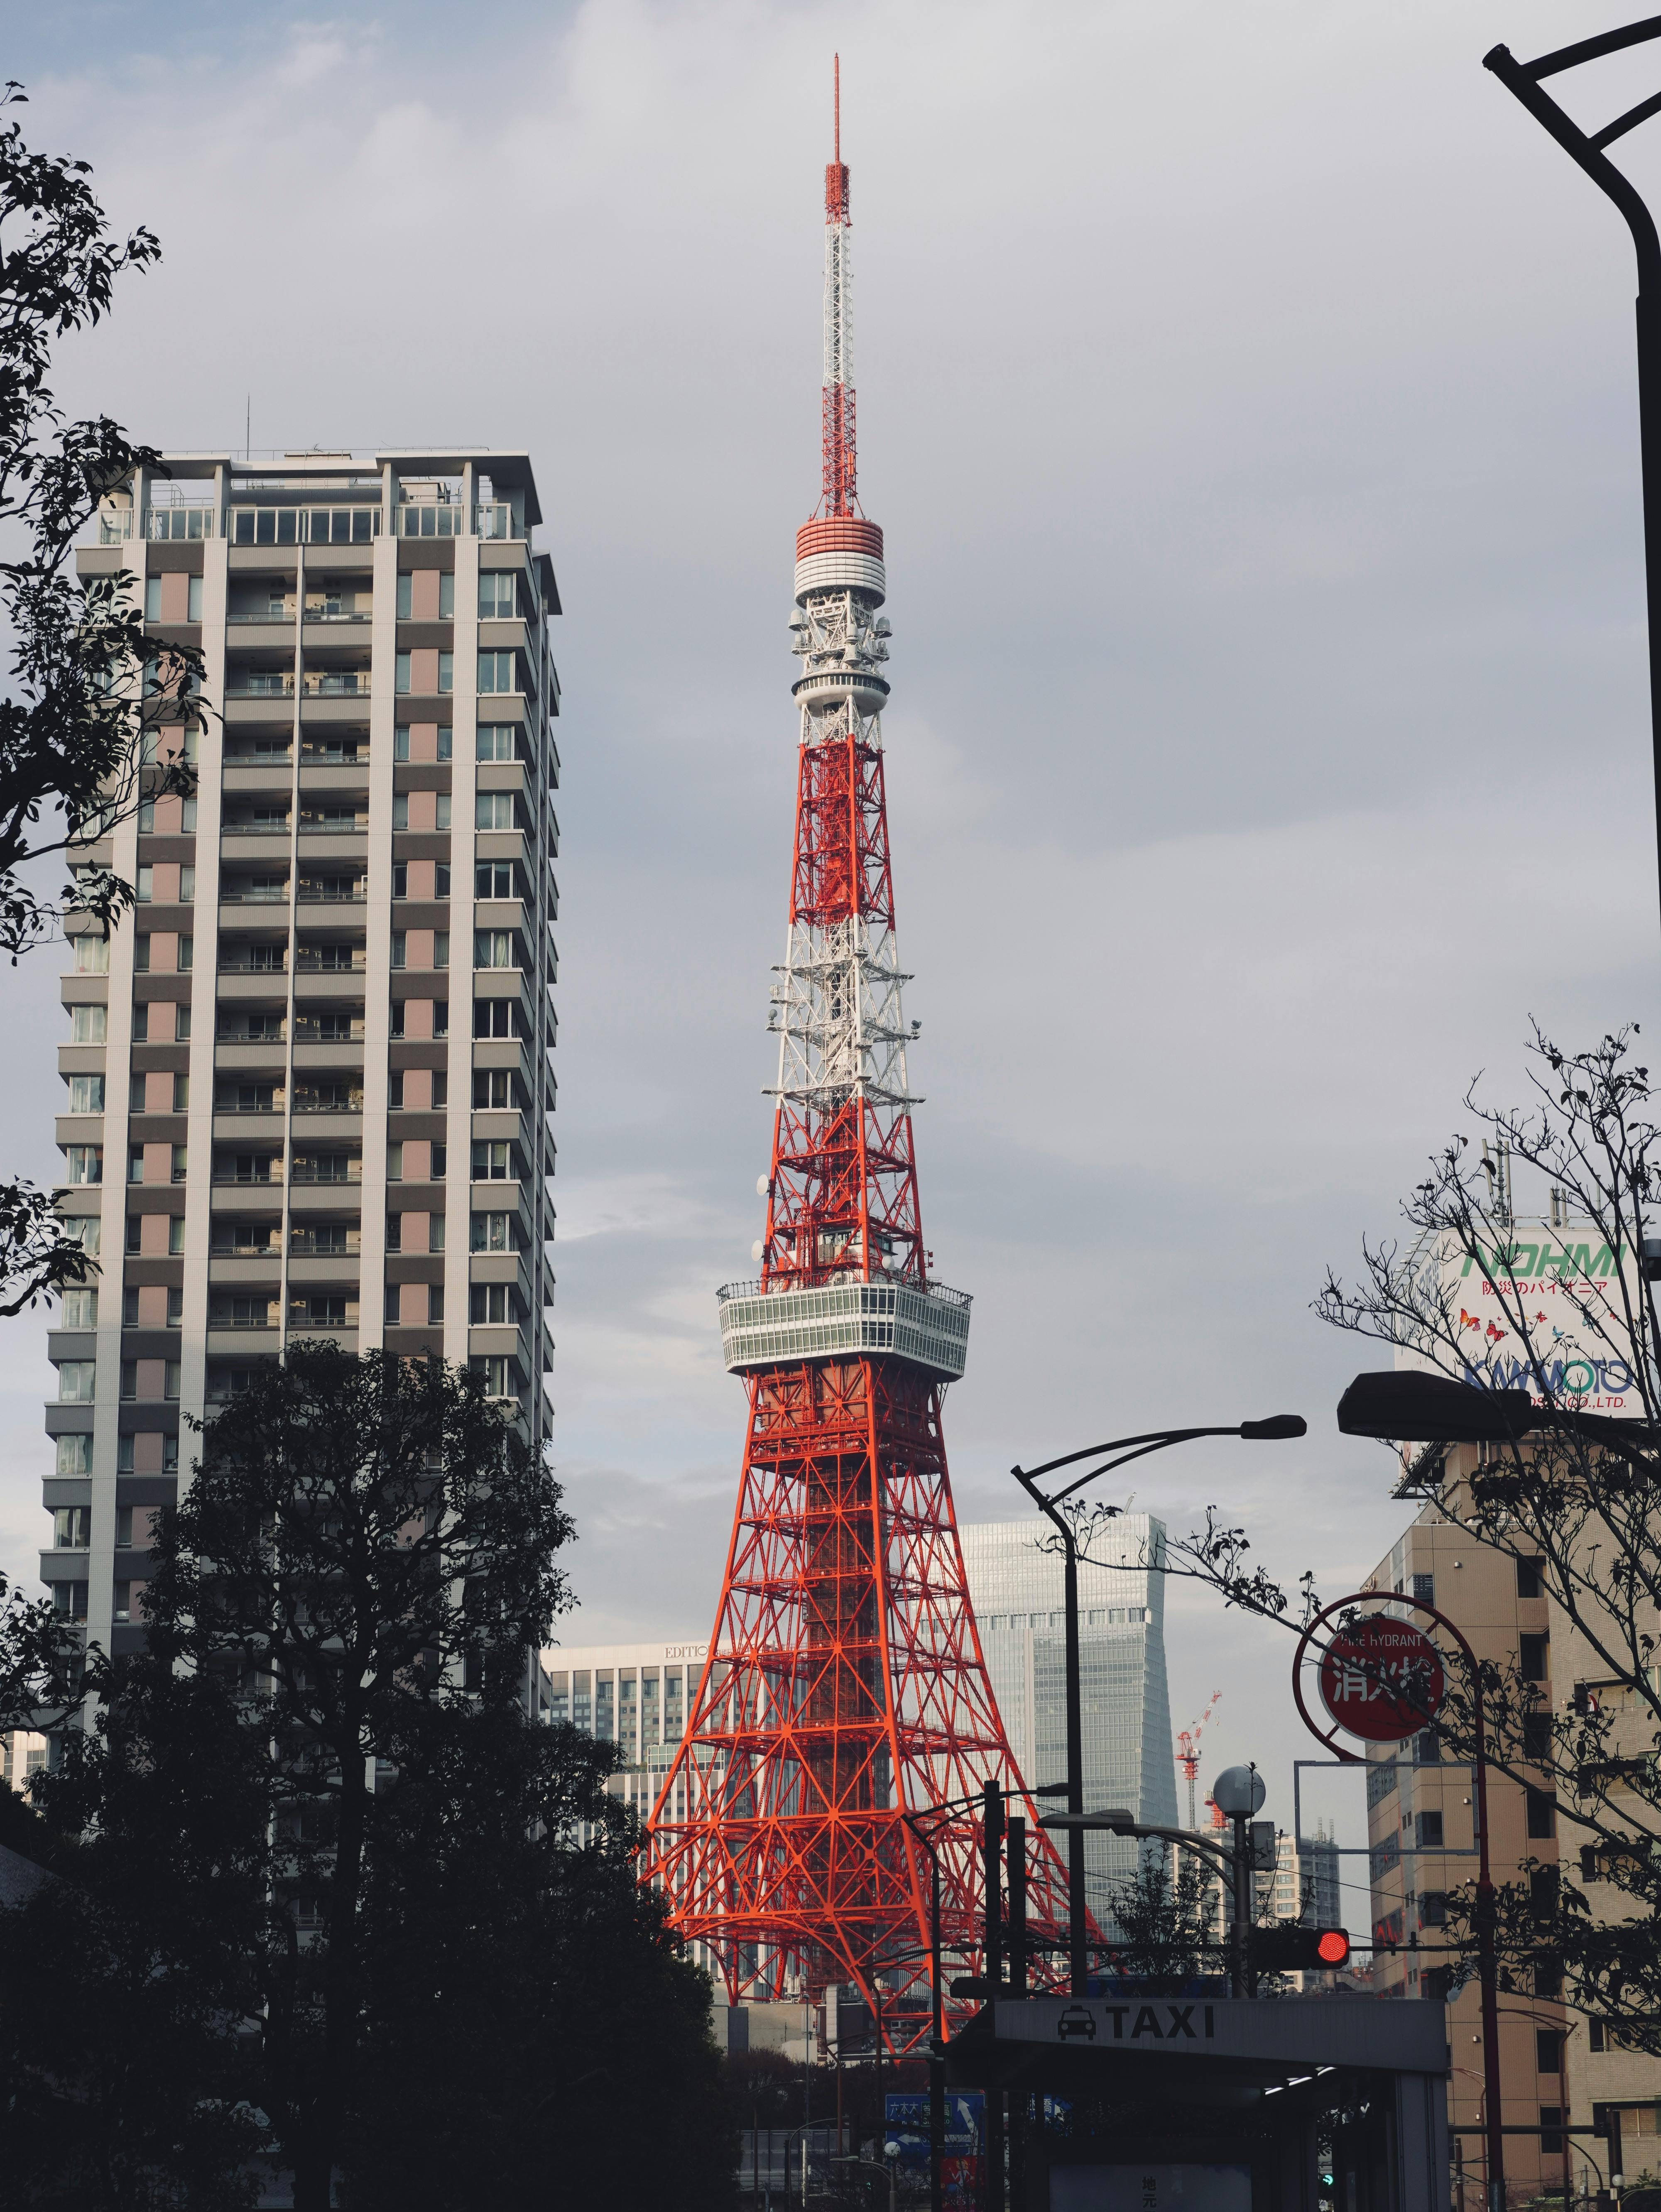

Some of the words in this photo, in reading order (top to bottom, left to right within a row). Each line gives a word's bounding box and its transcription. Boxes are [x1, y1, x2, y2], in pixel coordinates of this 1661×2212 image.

[1460, 1244, 1627, 1277] NOHMI
[1482, 1280, 1607, 1295] 防災のパイオニア
[1370, 1634, 1422, 1647] HYDRANT
[665, 1645, 710, 1658] EDITIO
[1106, 2006, 1214, 2038] TAXI
[890, 2101, 919, 2117] 六本木
[1142, 2176, 1156, 2212] 地元
